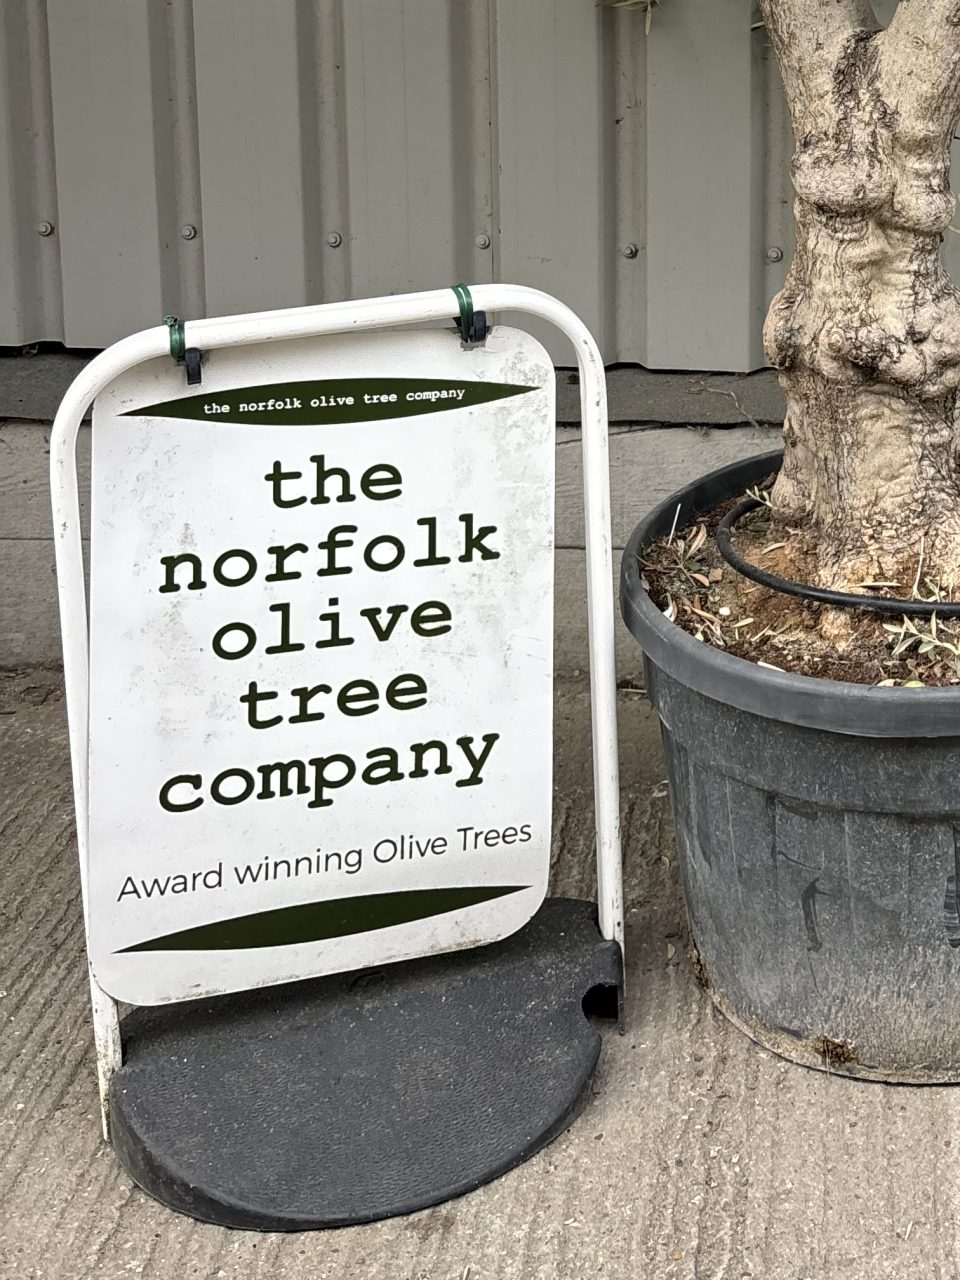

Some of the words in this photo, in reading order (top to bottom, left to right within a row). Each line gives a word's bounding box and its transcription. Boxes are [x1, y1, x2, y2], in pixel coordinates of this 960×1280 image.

[203, 403, 231, 415] the
[239, 397, 303, 412] norfolk
[310, 394, 355, 408] olive
[363, 392, 398, 404] tree
[405, 388, 466, 402] company
[264, 454, 403, 509] the
[158, 513, 501, 594] norfolk
[212, 597, 453, 661] olive
[239, 673, 428, 730] tree
[159, 733, 500, 813] company
[116, 862, 223, 902] Award
[234, 847, 363, 885] winning
[373, 836, 448, 864] Olive
[456, 820, 532, 851] Trees
